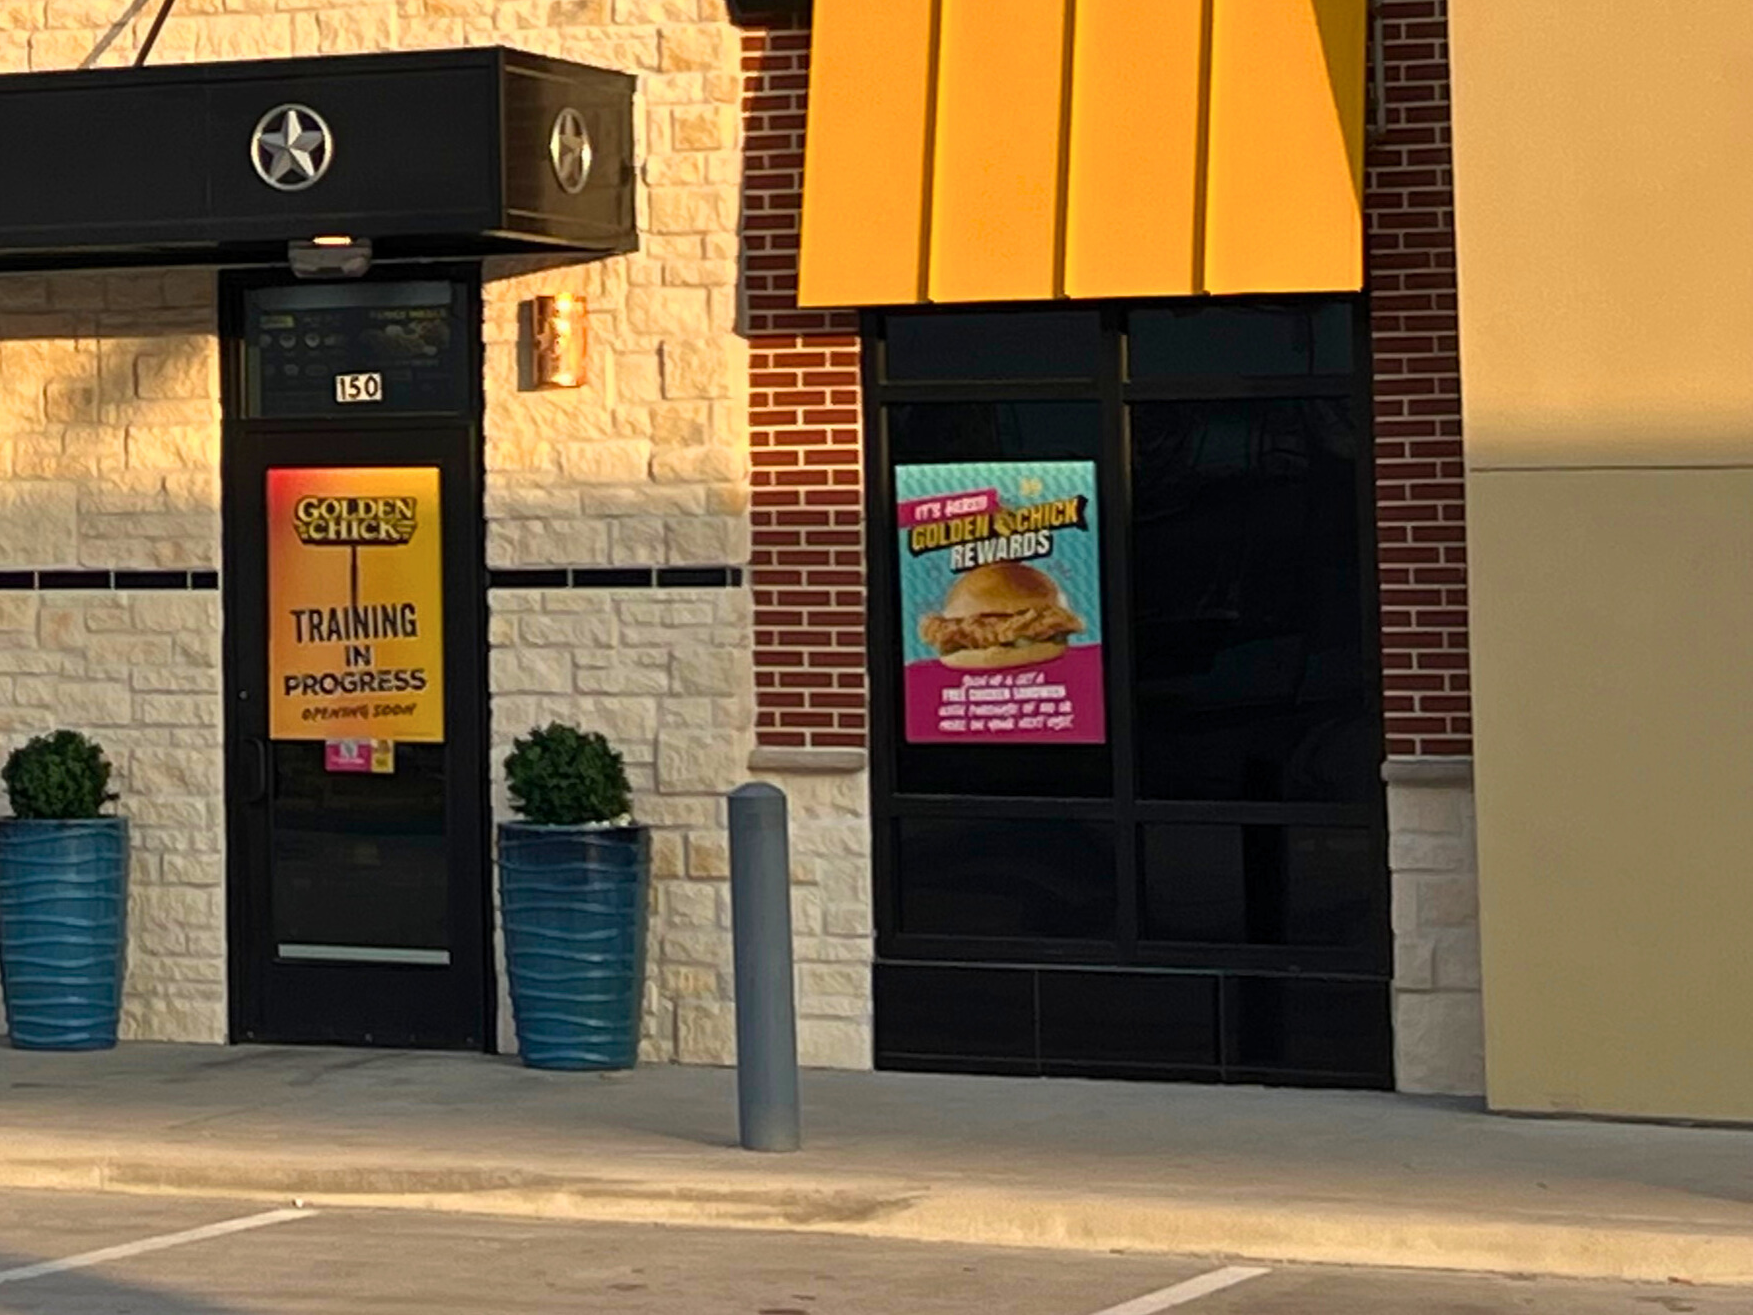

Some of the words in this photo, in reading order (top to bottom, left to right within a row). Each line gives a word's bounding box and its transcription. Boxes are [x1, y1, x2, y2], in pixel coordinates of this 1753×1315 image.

[339, 375, 379, 400] 150
[297, 497, 413, 522] GOLDEN
[309, 520, 401, 540] CHICK
[911, 514, 990, 551] GOLDEN
[1016, 498, 1079, 531] CHICK
[950, 530, 1050, 570] REWARDS
[289, 603, 418, 643] TRAINING
[345, 644, 371, 667] IN
[284, 669, 426, 696] PROGRESS
[301, 704, 369, 722] OPENING
[373, 702, 417, 718] SOON
